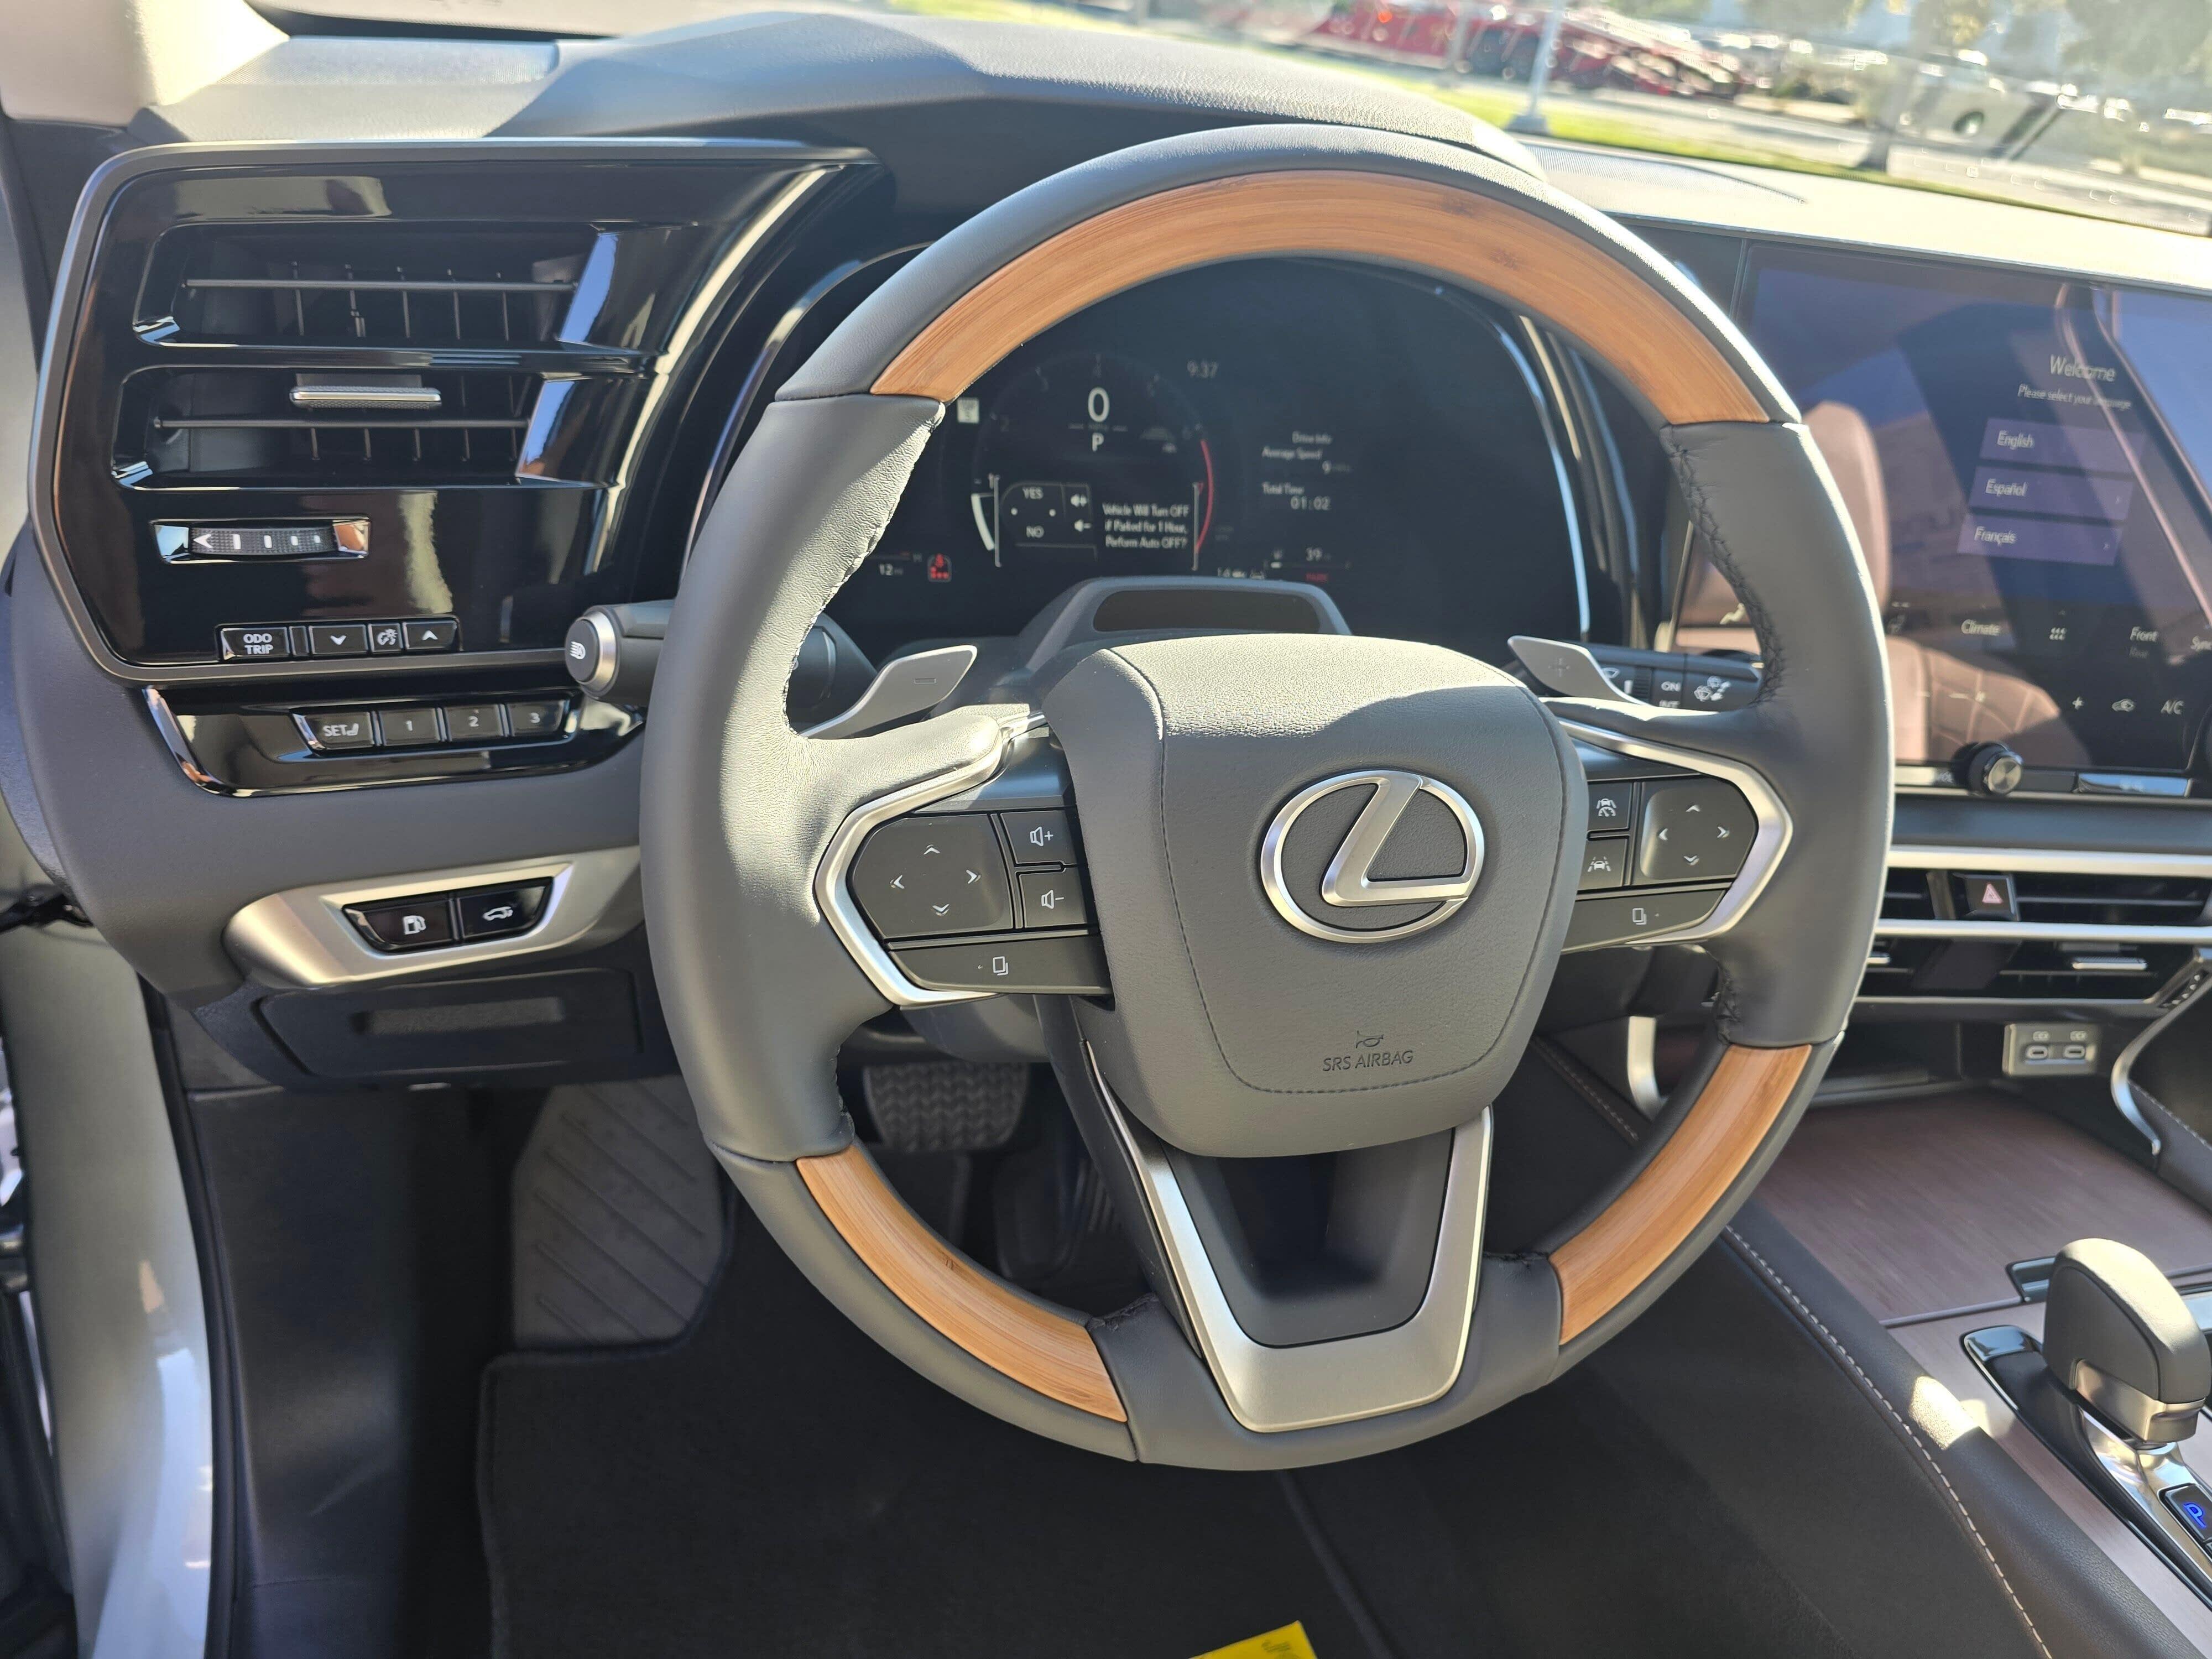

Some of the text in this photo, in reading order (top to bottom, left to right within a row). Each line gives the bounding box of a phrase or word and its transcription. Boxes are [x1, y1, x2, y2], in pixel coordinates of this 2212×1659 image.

[2017, 383, 2046, 400] Please
[1087, 387, 1110, 422] 0
[1091, 432, 1104, 452] P
[1997, 429, 2035, 450] English
[1022, 486, 1044, 499] YES
[1985, 478, 2028, 498] Español
[1290, 495, 1331, 510] 01:02
[1170, 504, 1190, 518] OFF
[1026, 526, 1045, 539] NO
[1974, 526, 2017, 546] Français
[1161, 536, 1188, 549] OFF?
[1961, 619, 2001, 637] Climate
[2130, 626, 2158, 642] Front
[243, 633, 273, 644] ODO
[244, 644, 274, 655] TRIP
[1661, 681, 1682, 692] ON
[2161, 699, 2185, 715] A/C
[468, 715, 479, 727] 2
[530, 712, 540, 724] 3
[322, 724, 346, 737] SET
[406, 721, 413, 732] 1
[1322, 1049, 1414, 1072] SRS AIRBAG
[2183, 1503, 2206, 1527] P
